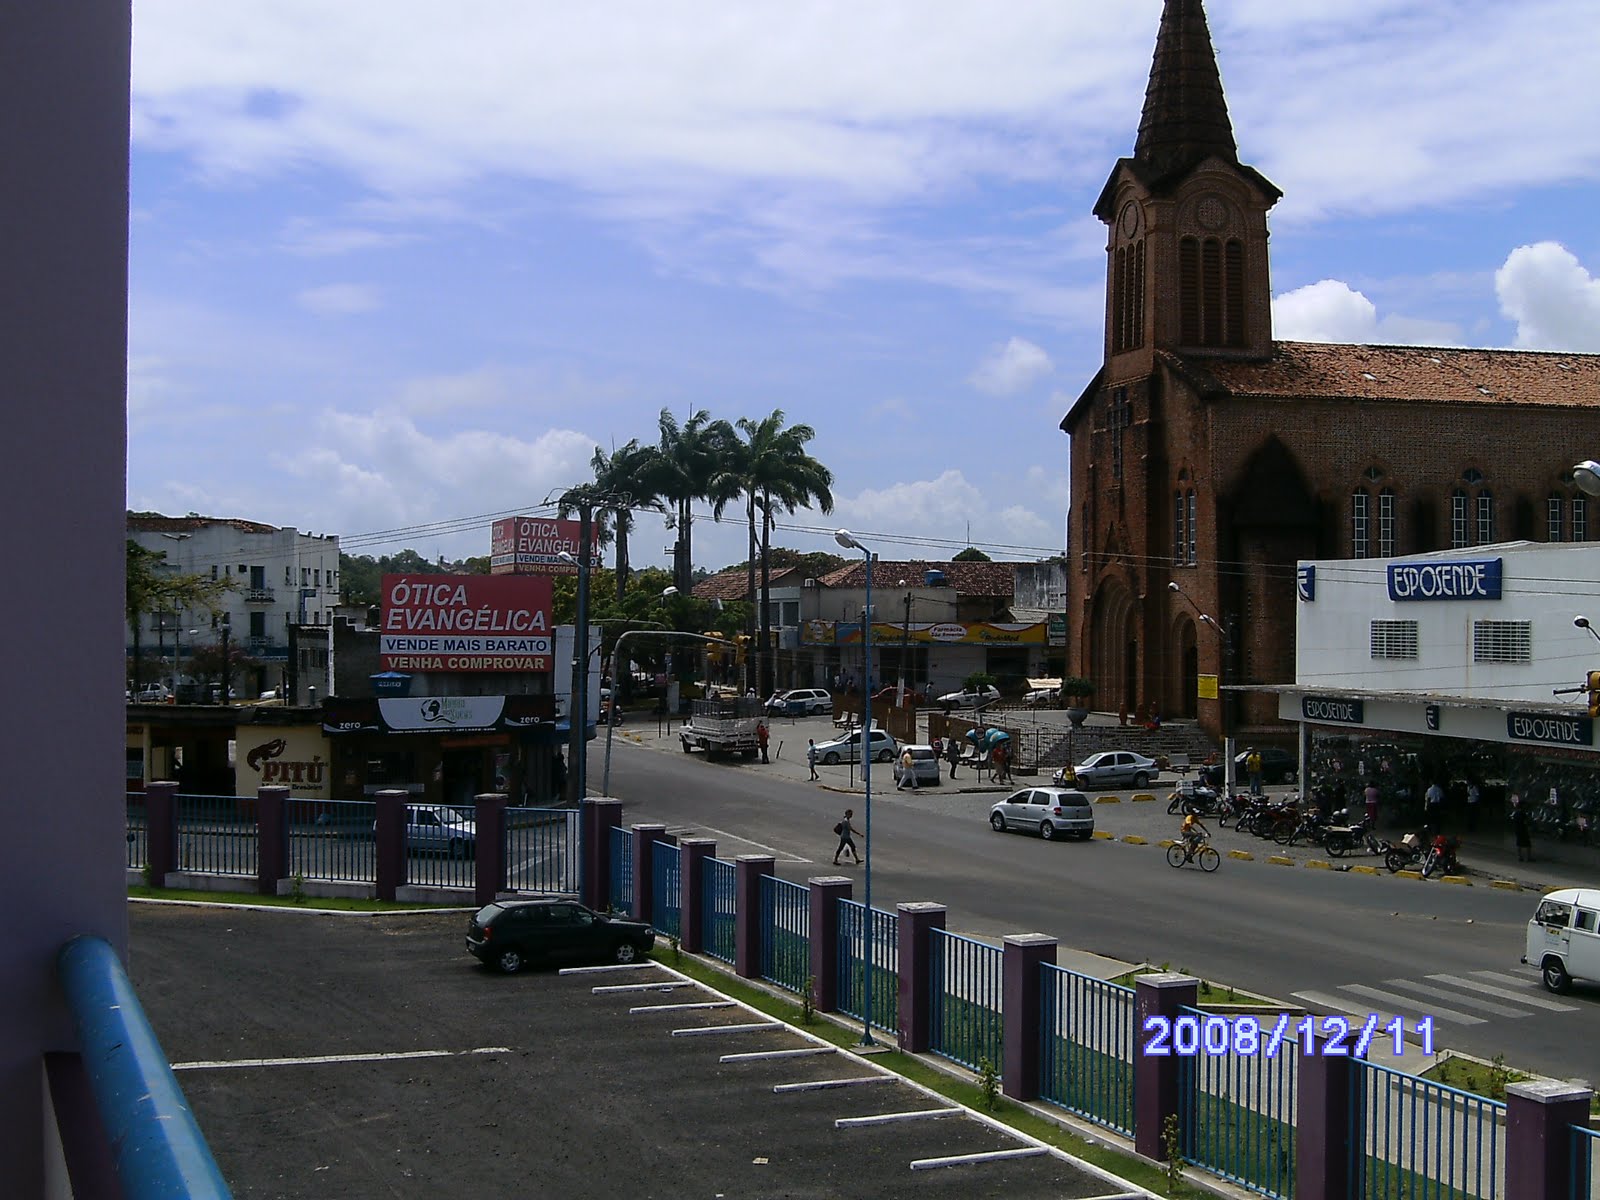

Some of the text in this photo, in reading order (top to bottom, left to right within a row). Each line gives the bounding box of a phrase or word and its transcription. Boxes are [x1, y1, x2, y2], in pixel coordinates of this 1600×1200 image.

[520, 519, 558, 537] ÓTICA
[518, 537, 596, 556] EVANGÉLIA
[519, 554, 545, 563] VENDE
[519, 564, 546, 572] VENHA
[1394, 565, 1487, 597] ESPOSENDE
[391, 579, 468, 606] ÓTICA
[386, 604, 546, 631] EVANGÉLICA
[386, 639, 547, 652] VENDE MAIS BARATO
[387, 657, 545, 669] VENHA COMPROVAR
[1306, 700, 1354, 721] ESPOSENDE
[340, 720, 361, 729] zero
[520, 716, 540, 724] zero
[1514, 717, 1581, 742] ESPOSENDE
[262, 755, 324, 783] PITÚ
